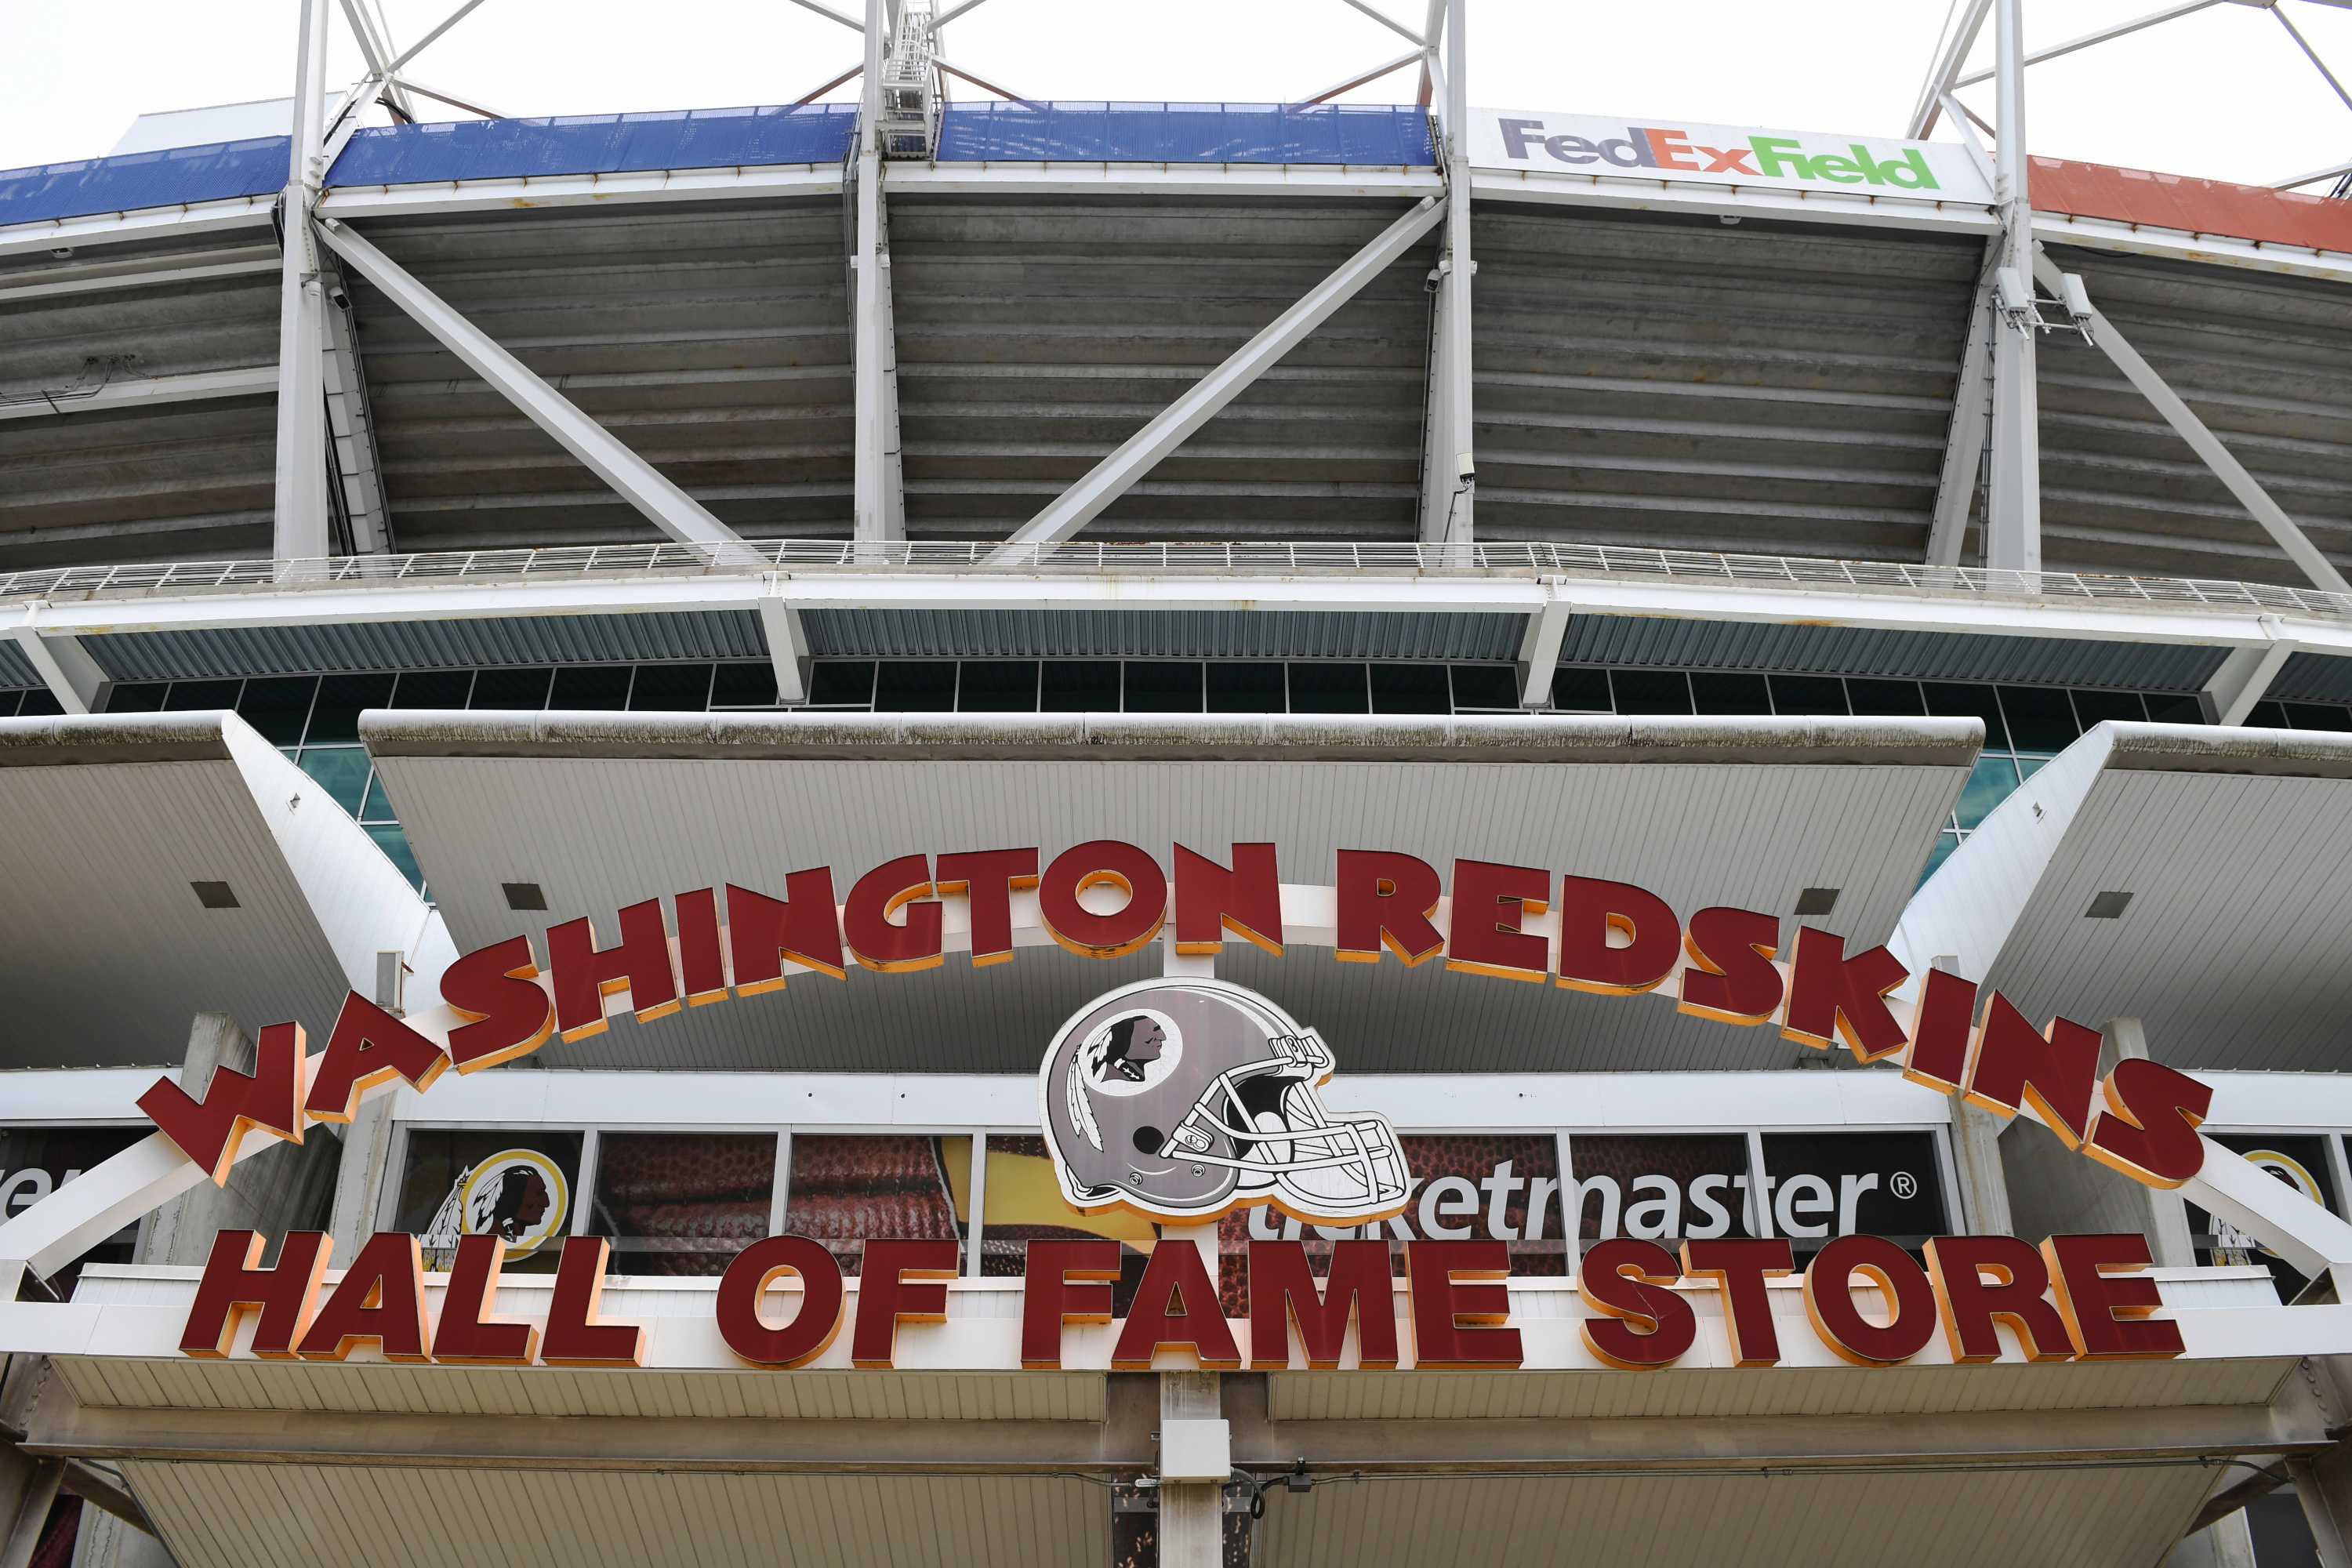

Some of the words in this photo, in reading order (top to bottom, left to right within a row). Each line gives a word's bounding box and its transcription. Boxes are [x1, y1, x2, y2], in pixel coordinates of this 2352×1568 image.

[135, 840, 1284, 1188] WASHINGTON
[1335, 848, 2215, 1190] REDSKINS
[179, 1229, 645, 1367] HALL
[716, 1234, 960, 1370] OF
[1021, 1238, 1524, 1370] FAME
[1577, 1232, 2187, 1371] STORE
